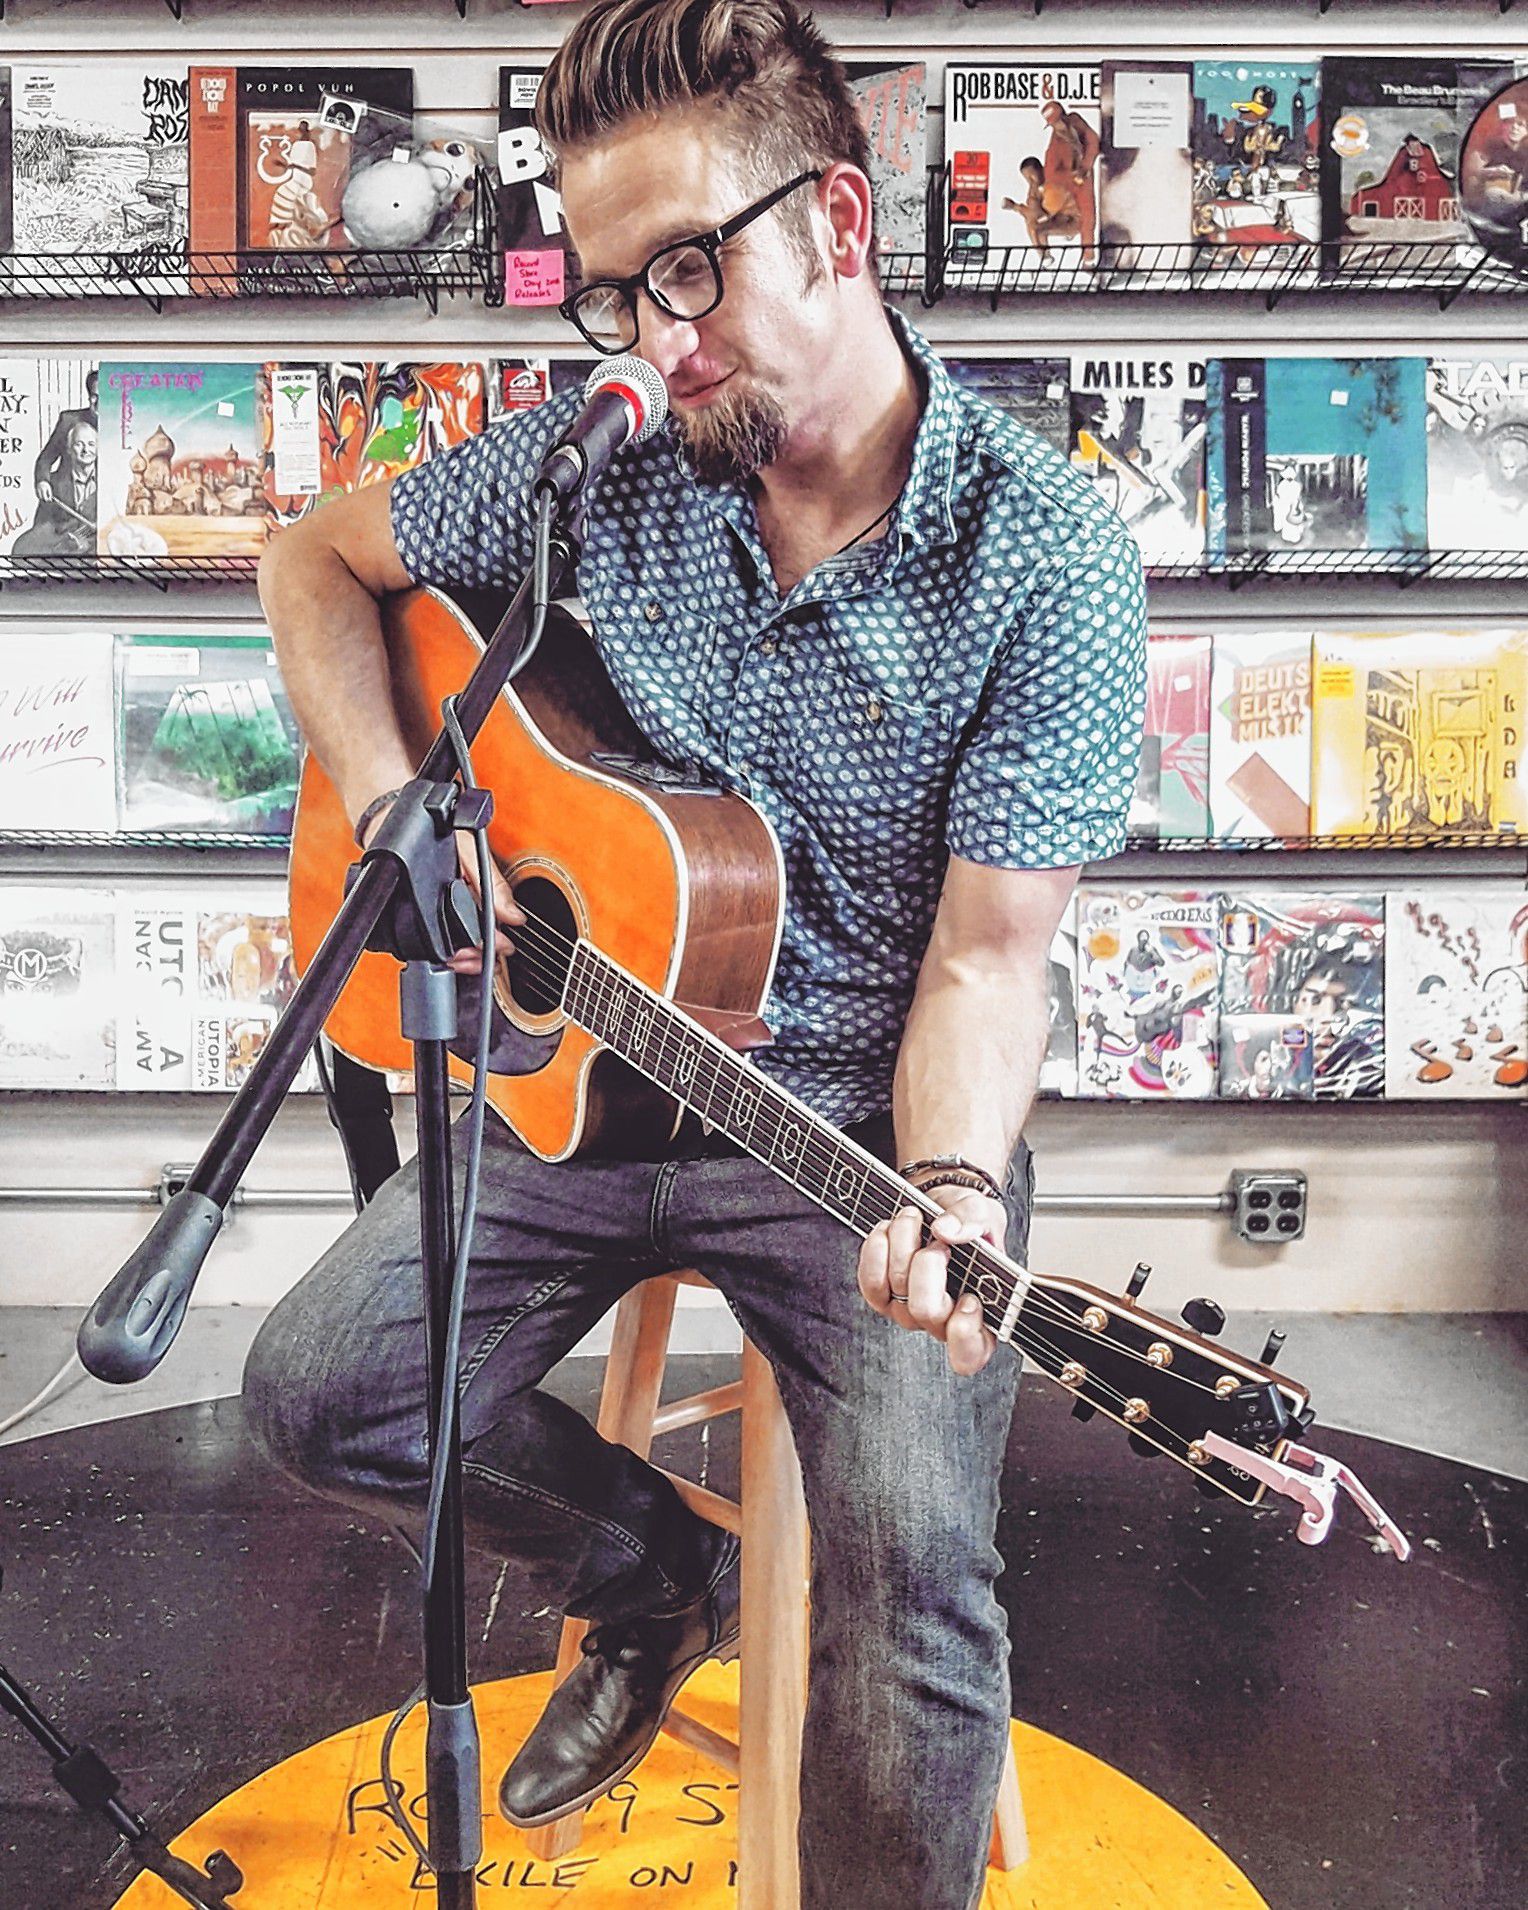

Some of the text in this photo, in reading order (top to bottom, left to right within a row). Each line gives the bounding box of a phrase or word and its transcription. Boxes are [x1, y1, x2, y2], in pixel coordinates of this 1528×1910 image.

[246, 83, 354, 93] POPOL VUH
[953, 73, 991, 122] ROB
[994, 73, 1039, 100] BASE
[1042, 73, 1054, 100] &
[1381, 84, 1402, 95] The
[1404, 84, 1432, 95] Beau
[498, 126, 548, 186] B
[524, 280, 541, 289] Day
[1083, 361, 1174, 388] MILES
[0, 475, 21, 488] DS
[208, 1020, 219, 1087] UTOPIA
[629, 1861, 693, 1887] ON
